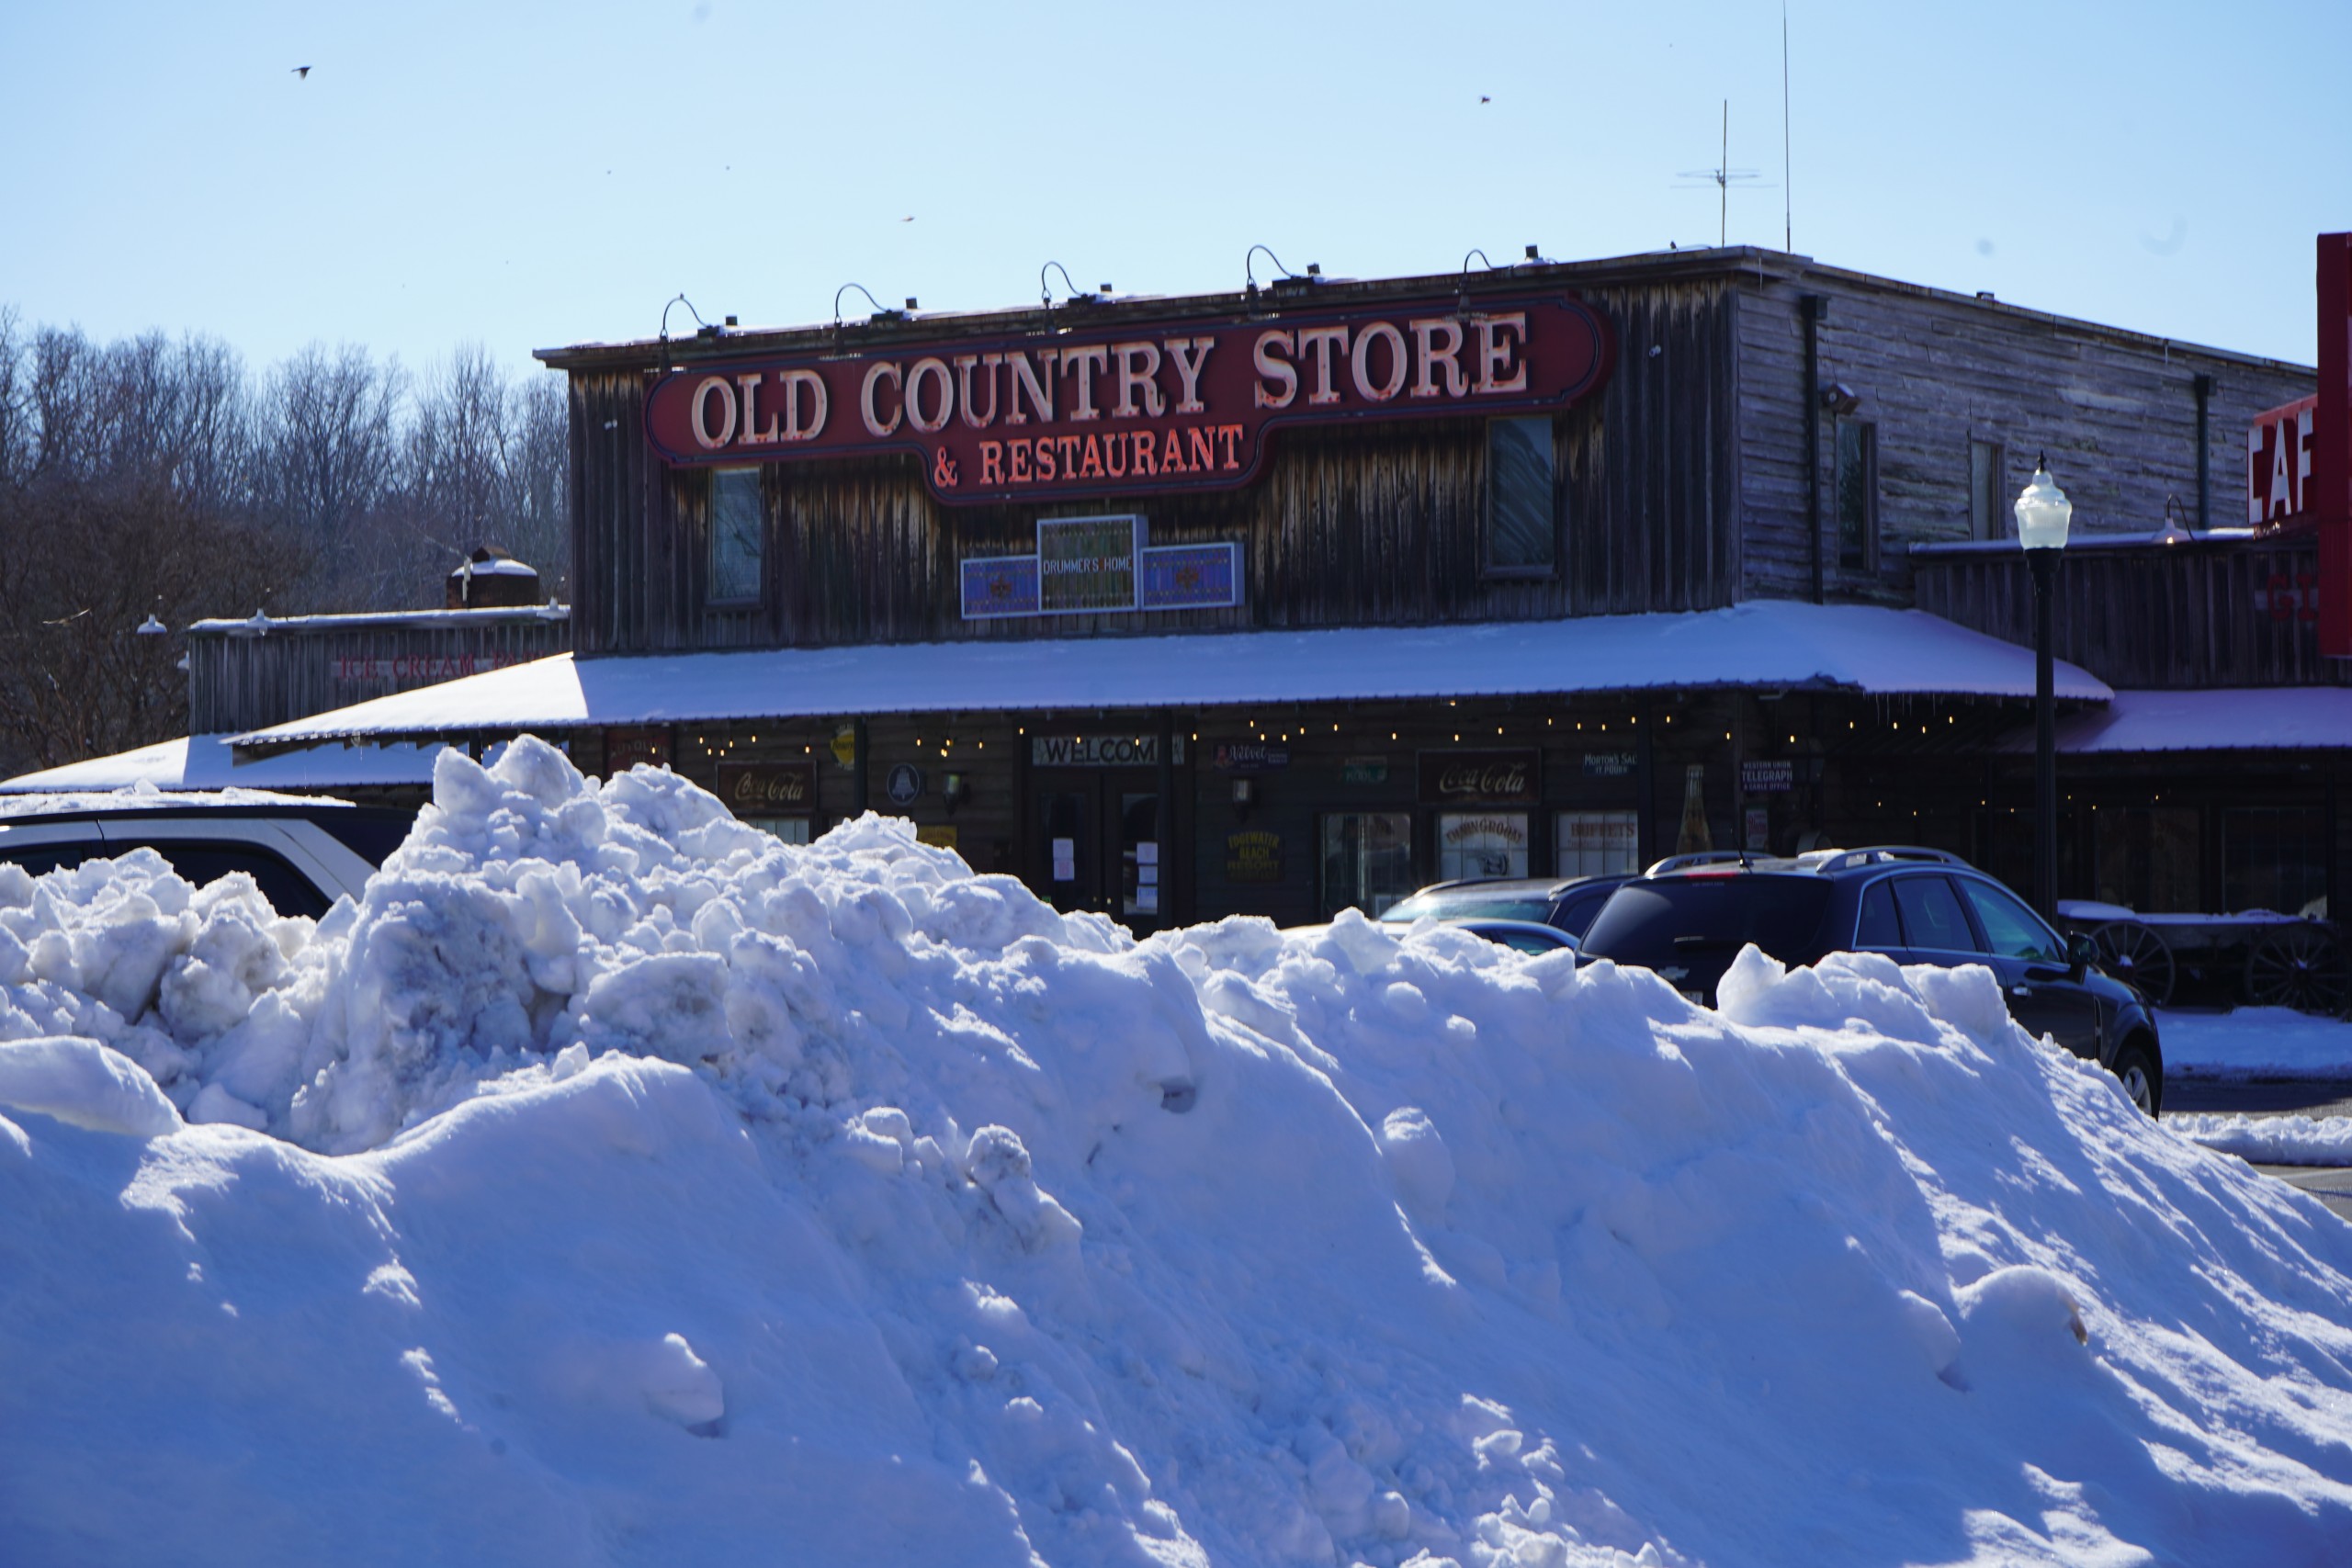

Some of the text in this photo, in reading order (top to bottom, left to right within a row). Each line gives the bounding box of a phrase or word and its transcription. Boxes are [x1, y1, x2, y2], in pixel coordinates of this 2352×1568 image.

[691, 311, 1528, 450] OLD COUNTRY STORE
[934, 423, 1244, 488] & RESTAURANT
[2247, 407, 2313, 525] CAF
[1043, 555, 1132, 575] DRUMMER'S HOME
[2267, 572, 2319, 621] GI
[340, 656, 378, 679] ICE
[392, 652, 475, 678] CREAM
[1045, 739, 1157, 763] WELCOM
[1229, 744, 1266, 761] Velvet
[1621, 752, 1638, 765] SAL
[1440, 761, 1529, 795] Coca-Cola
[1741, 770, 1792, 783] TELEGRAPH
[1743, 760, 1791, 770] WESTERN UNION
[734, 771, 805, 801] Coca-Cola
